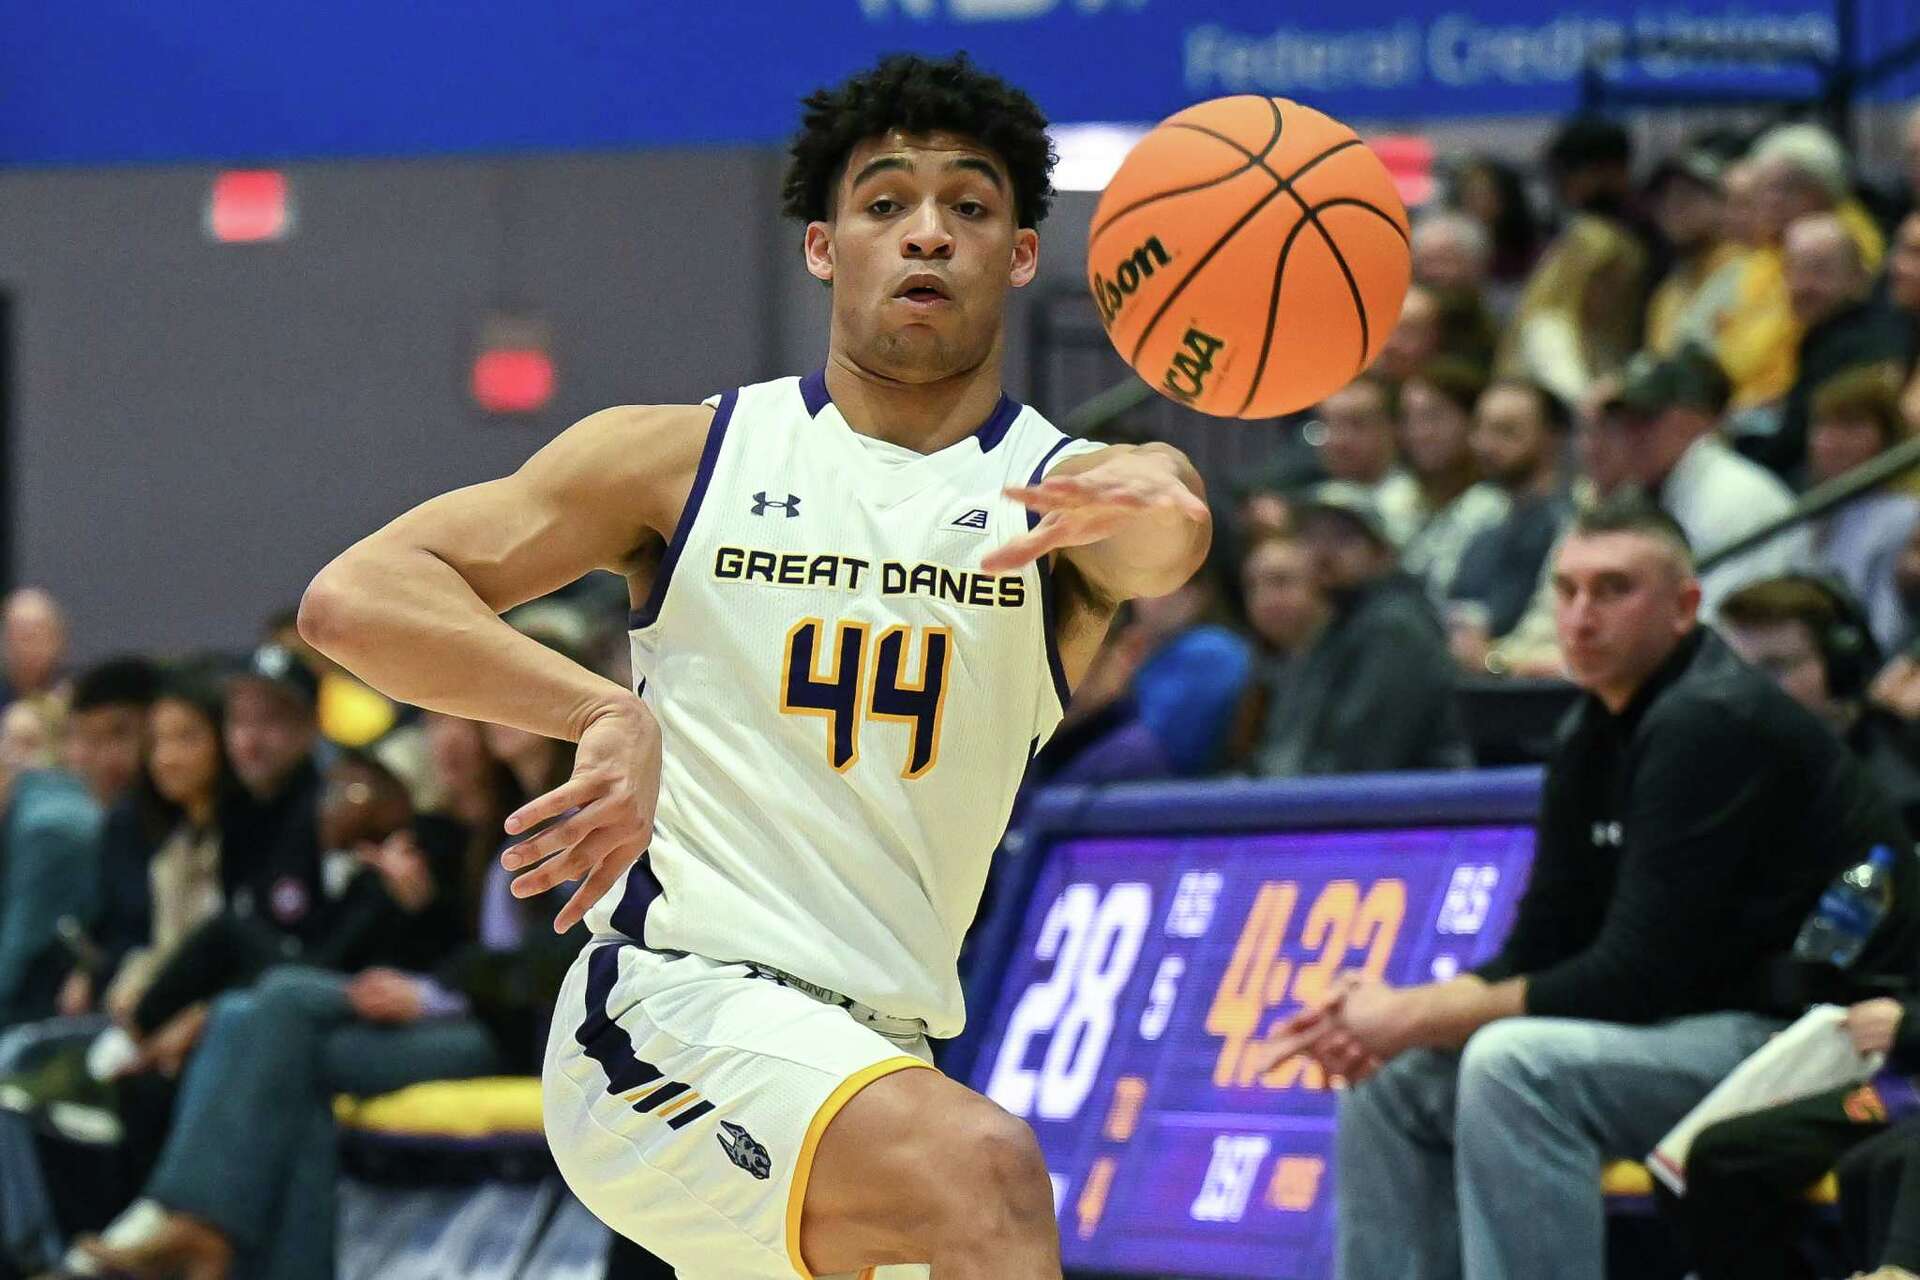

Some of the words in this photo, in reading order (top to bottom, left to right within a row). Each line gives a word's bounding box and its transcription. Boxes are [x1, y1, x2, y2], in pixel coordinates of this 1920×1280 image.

[1162, 328, 1224, 403] CAA
[714, 547, 869, 590] GREAT
[882, 562, 1025, 608] DANES
[779, 616, 952, 780] 44
[985, 882, 1152, 1120] 28
